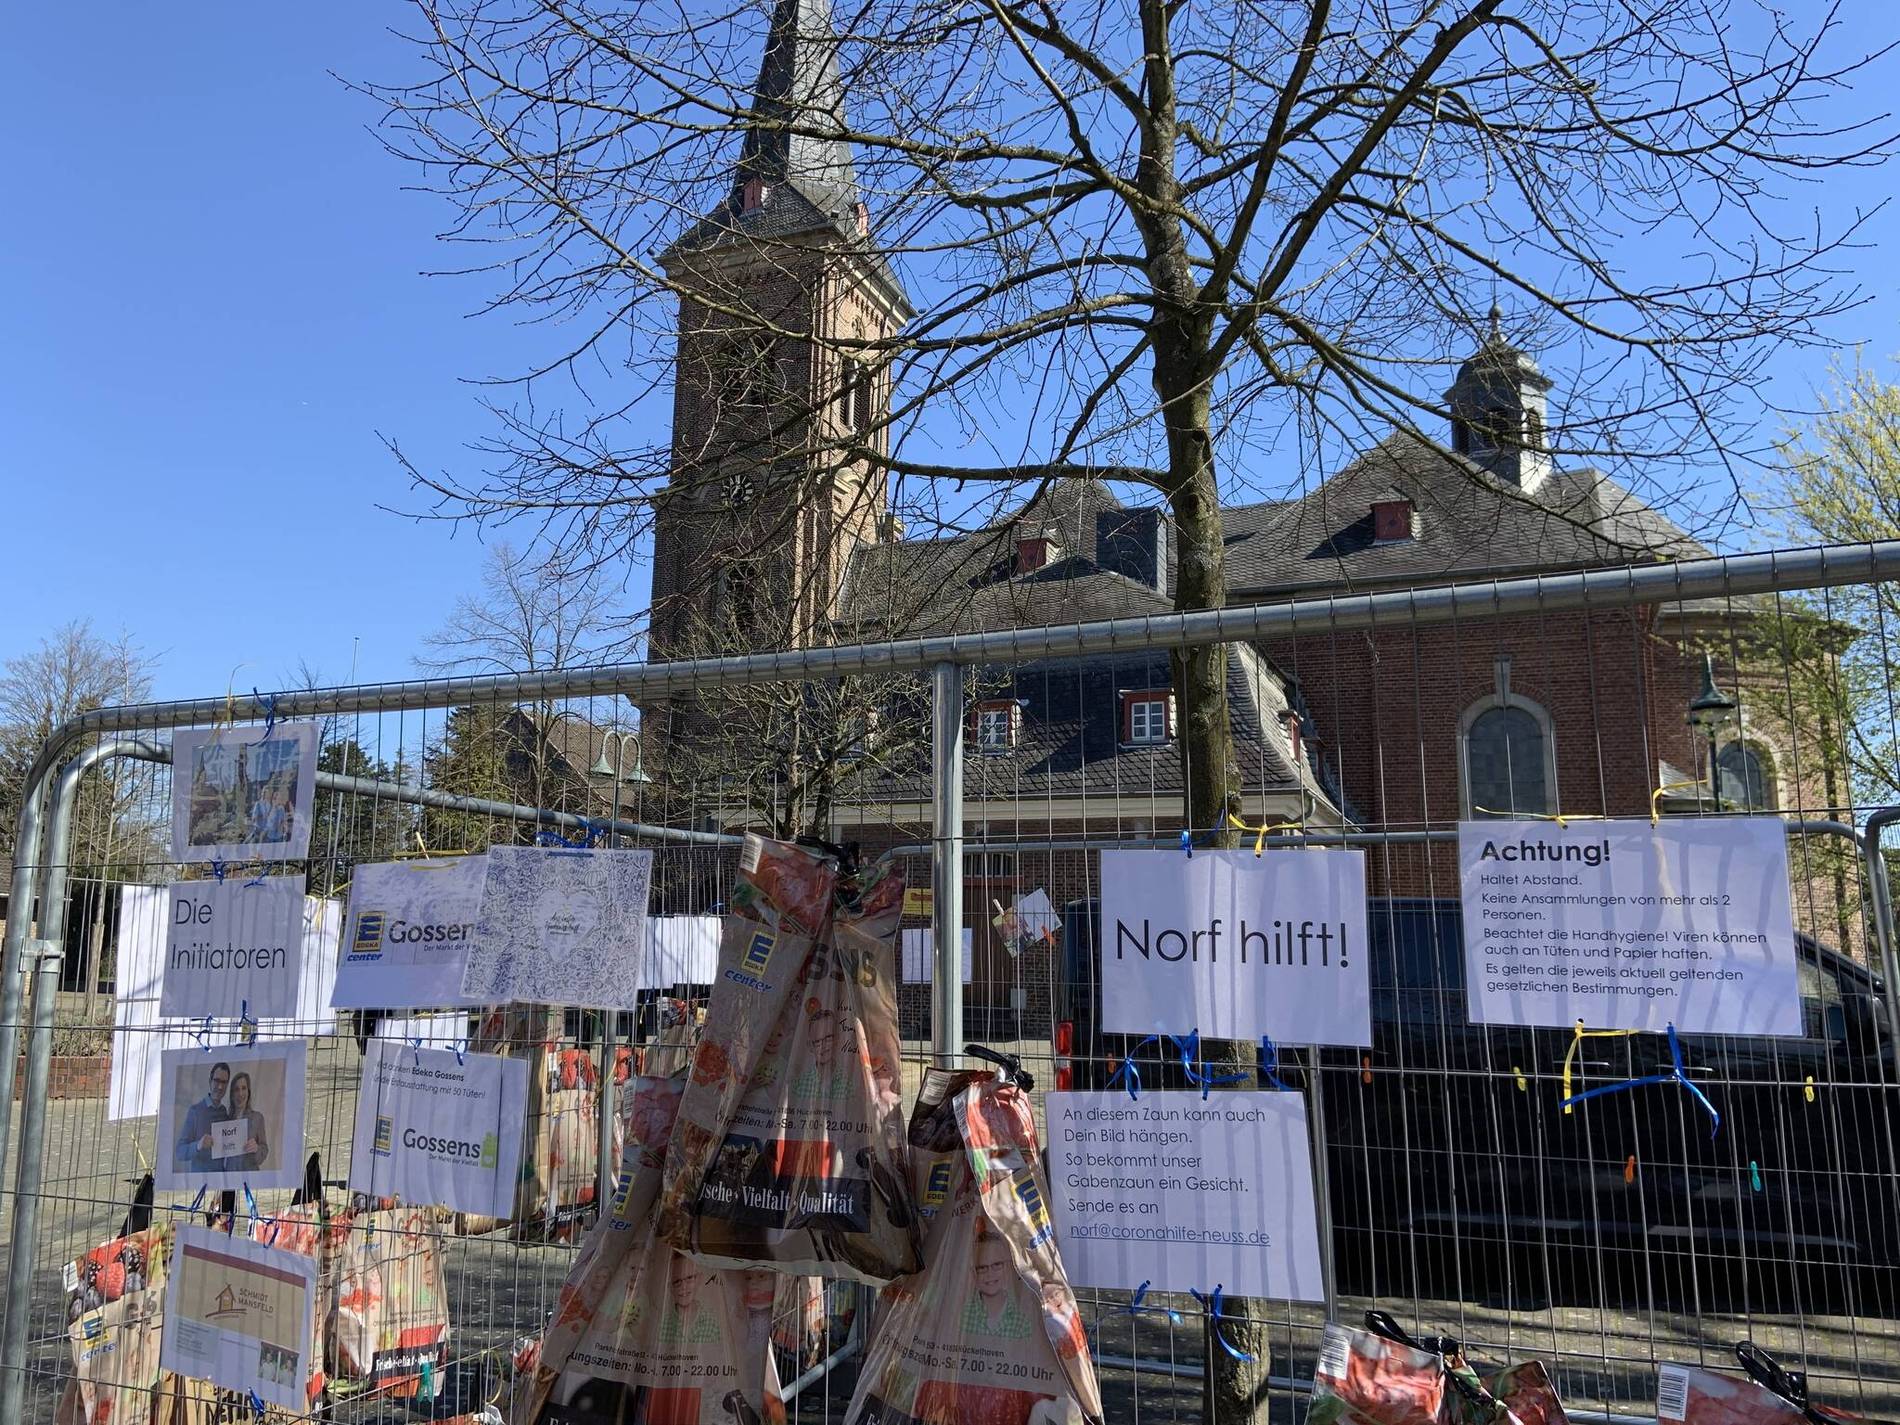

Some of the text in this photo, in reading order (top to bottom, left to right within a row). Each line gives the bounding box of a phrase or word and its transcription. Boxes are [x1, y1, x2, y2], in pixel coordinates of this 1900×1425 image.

[1480, 840, 1611, 866] Achtung!
[1481, 874, 1582, 885] Haltet Abstand.
[1482, 893, 1731, 907] Keine Ansammlungen von mehr als 2
[175, 899, 212, 924] Die
[1483, 910, 1546, 920] Personen.
[1117, 918, 1349, 968] Norf hilft!
[1484, 929, 1767, 944] Beachtet die Handhygiene! Viren können
[171, 944, 285, 970] Initiatoren
[1485, 945, 1712, 960] auch an Tüten und Papier haften.
[725, 970, 772, 992] center
[1486, 964, 1743, 981] Es gelten die jeweils aktuell geltenden
[1488, 981, 1678, 998] gesetzlichen Bestimmungen.
[412, 1067, 432, 1077] Edeka
[435, 1071, 464, 1081] Gossens
[1064, 1108, 1265, 1122] An diesem Zaun kann auch
[222, 1127, 237, 1136] Norf
[1064, 1129, 1192, 1146] Dein Bild hängen.
[403, 1128, 480, 1158] Gossens
[1066, 1153, 1202, 1168] So bekommt unser
[1067, 1175, 1248, 1192] Gabenzaun ein Gesicht.
[742, 1186, 791, 1211] Vielfalt
[800, 1191, 854, 1216] Qualität
[1068, 1199, 1158, 1214] Sende es an
[1070, 1223, 1270, 1245] norf@coronahilfe-neuss.de
[662, 1366, 681, 1376] 7.00
[691, 1366, 718, 1376] 22.00
[961, 1359, 985, 1372] 7.00
[996, 1363, 1027, 1377] 22.00
[1032, 1368, 1055, 1381] Uhr
